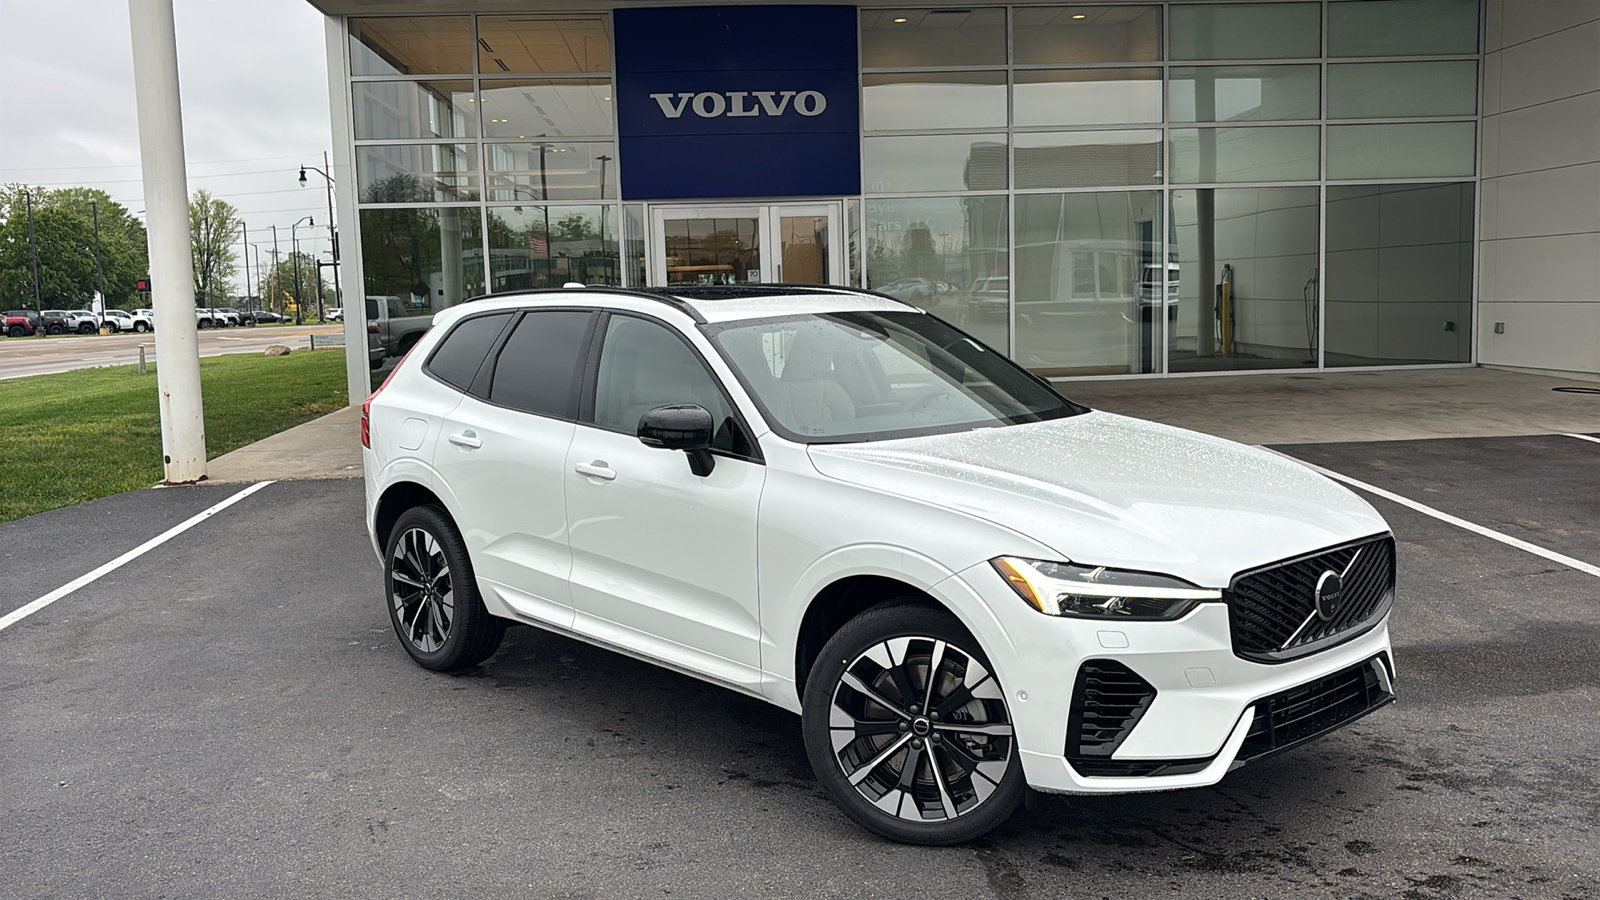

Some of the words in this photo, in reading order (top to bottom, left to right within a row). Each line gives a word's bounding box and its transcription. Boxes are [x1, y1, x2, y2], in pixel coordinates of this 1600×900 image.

[649, 90, 827, 119] VOLVO
[867, 218, 902, 231] Cars
[907, 217, 936, 230] LLC
